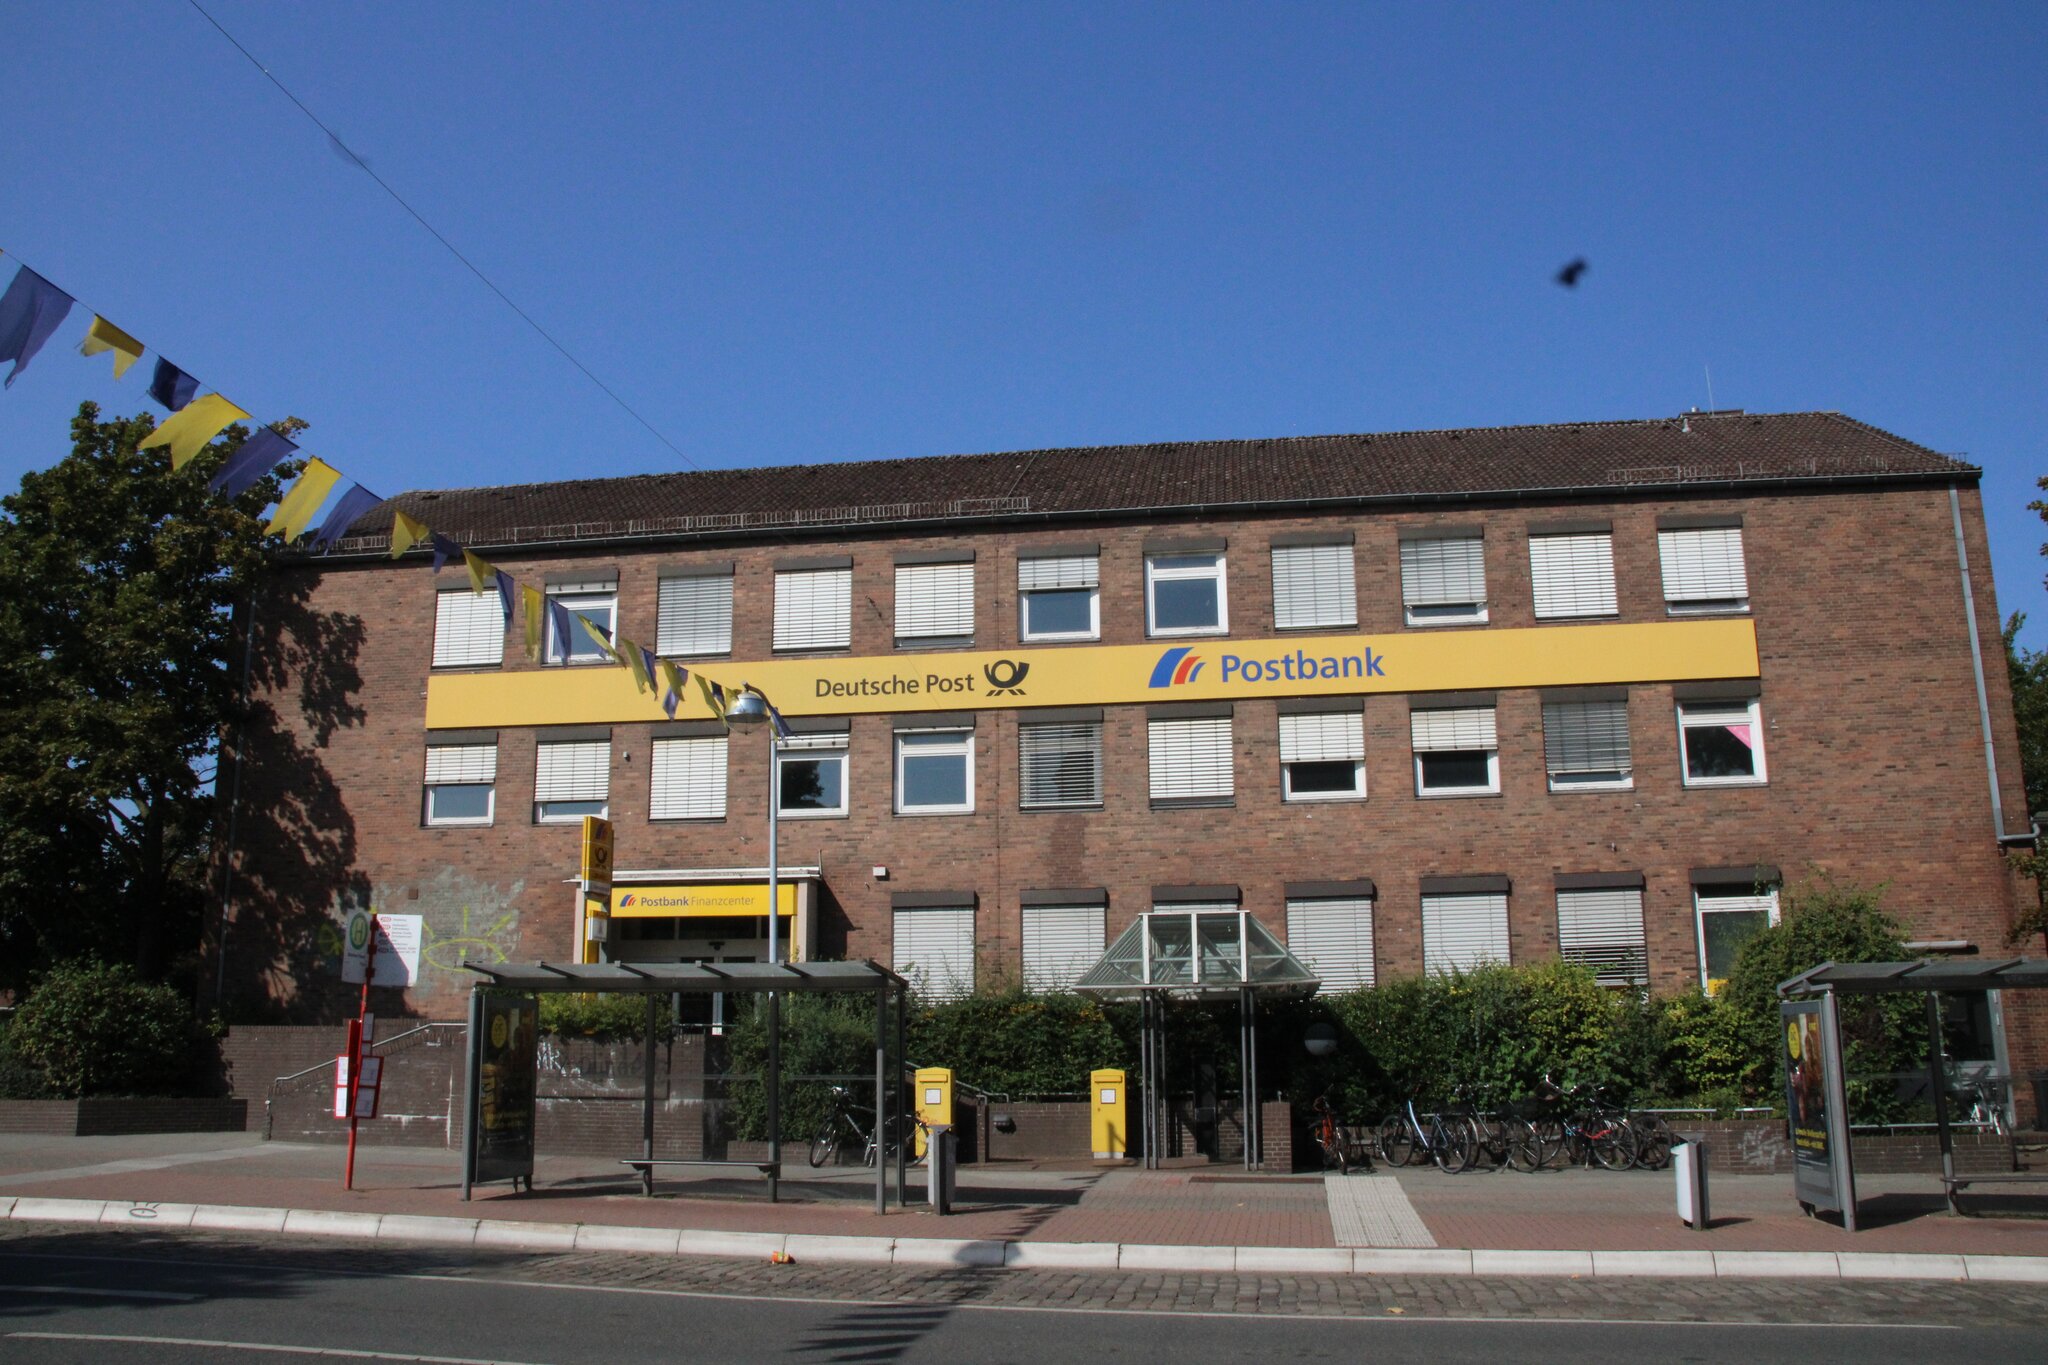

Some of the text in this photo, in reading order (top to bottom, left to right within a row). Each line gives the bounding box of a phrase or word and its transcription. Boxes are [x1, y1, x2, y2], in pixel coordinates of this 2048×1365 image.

[1222, 646, 1385, 682] Postbank
[816, 674, 974, 697] Deutsche Post
[641, 896, 754, 907] Postbank Finanzcenter
